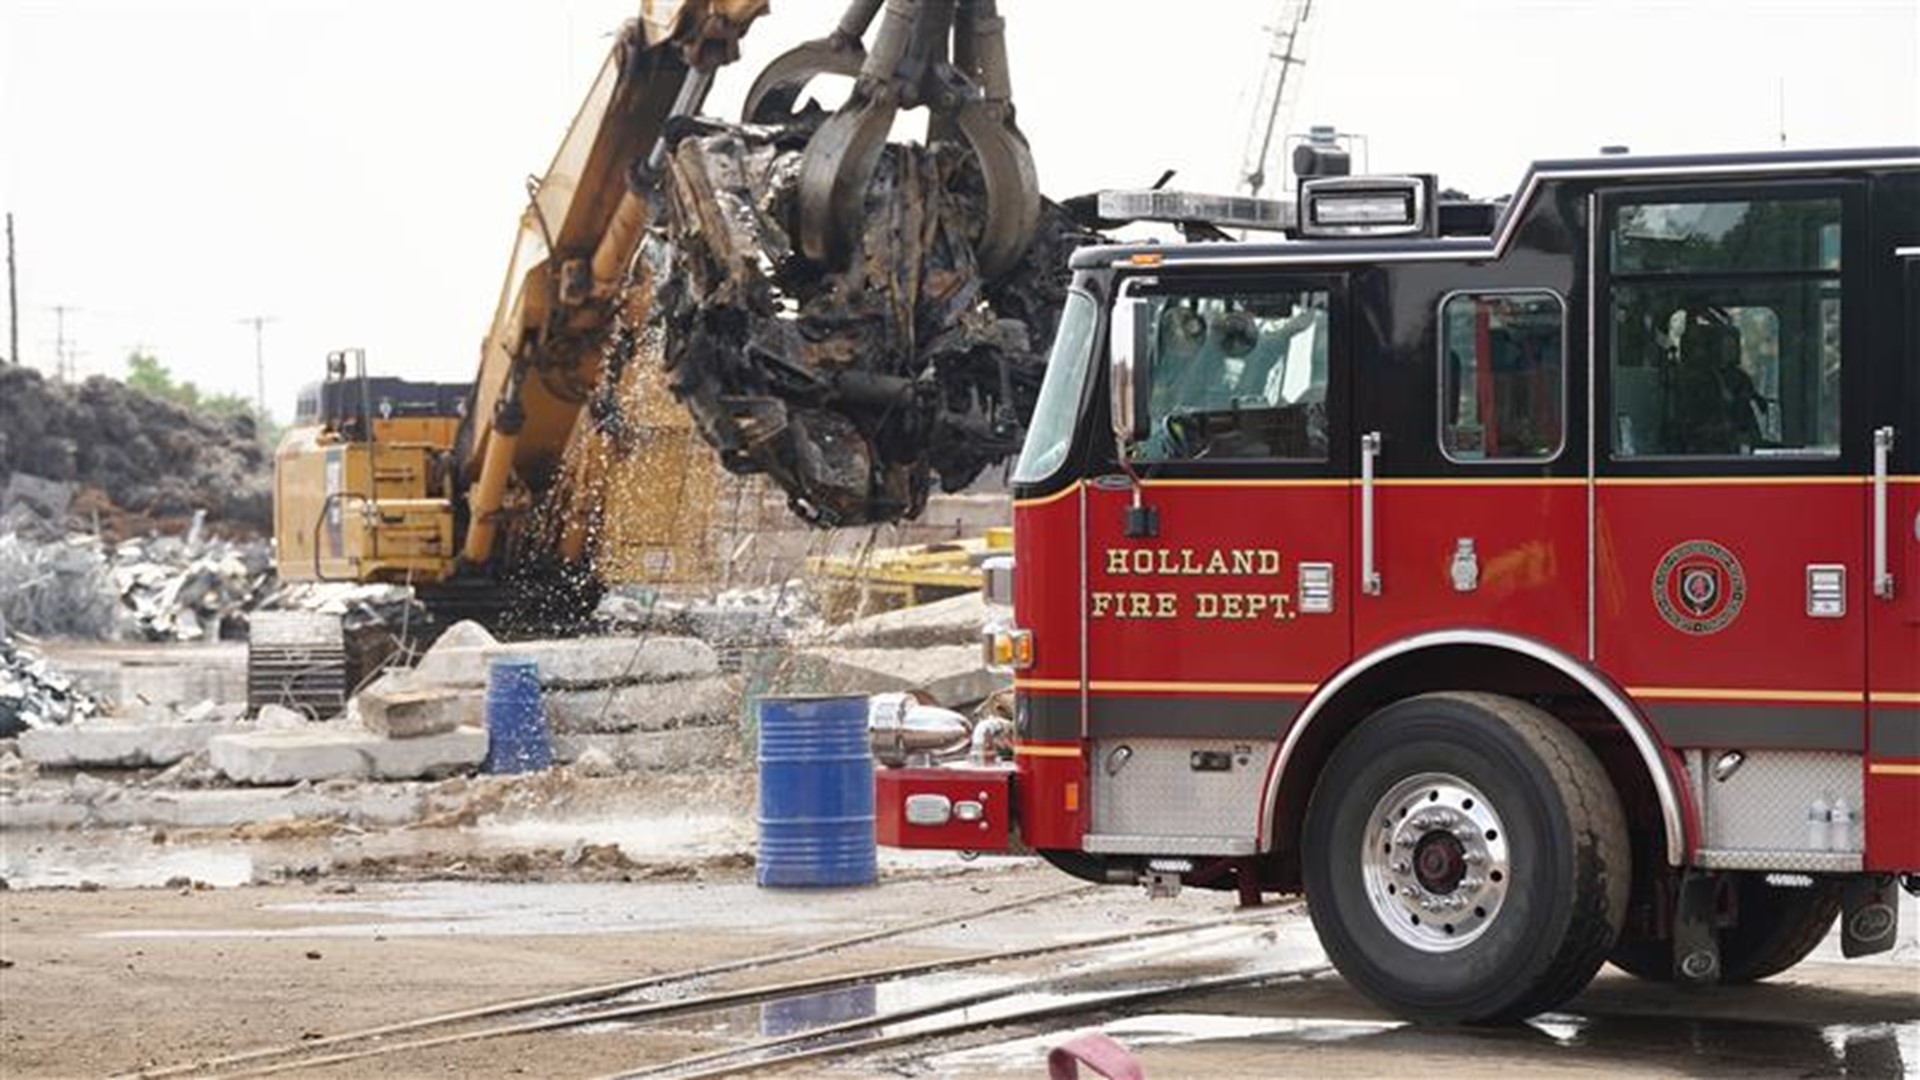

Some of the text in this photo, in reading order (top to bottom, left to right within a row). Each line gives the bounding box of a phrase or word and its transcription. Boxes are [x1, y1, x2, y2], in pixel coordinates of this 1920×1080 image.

[1106, 549, 1280, 574] HOLLAND
[1091, 592, 1297, 619] FIRE DEPT.
